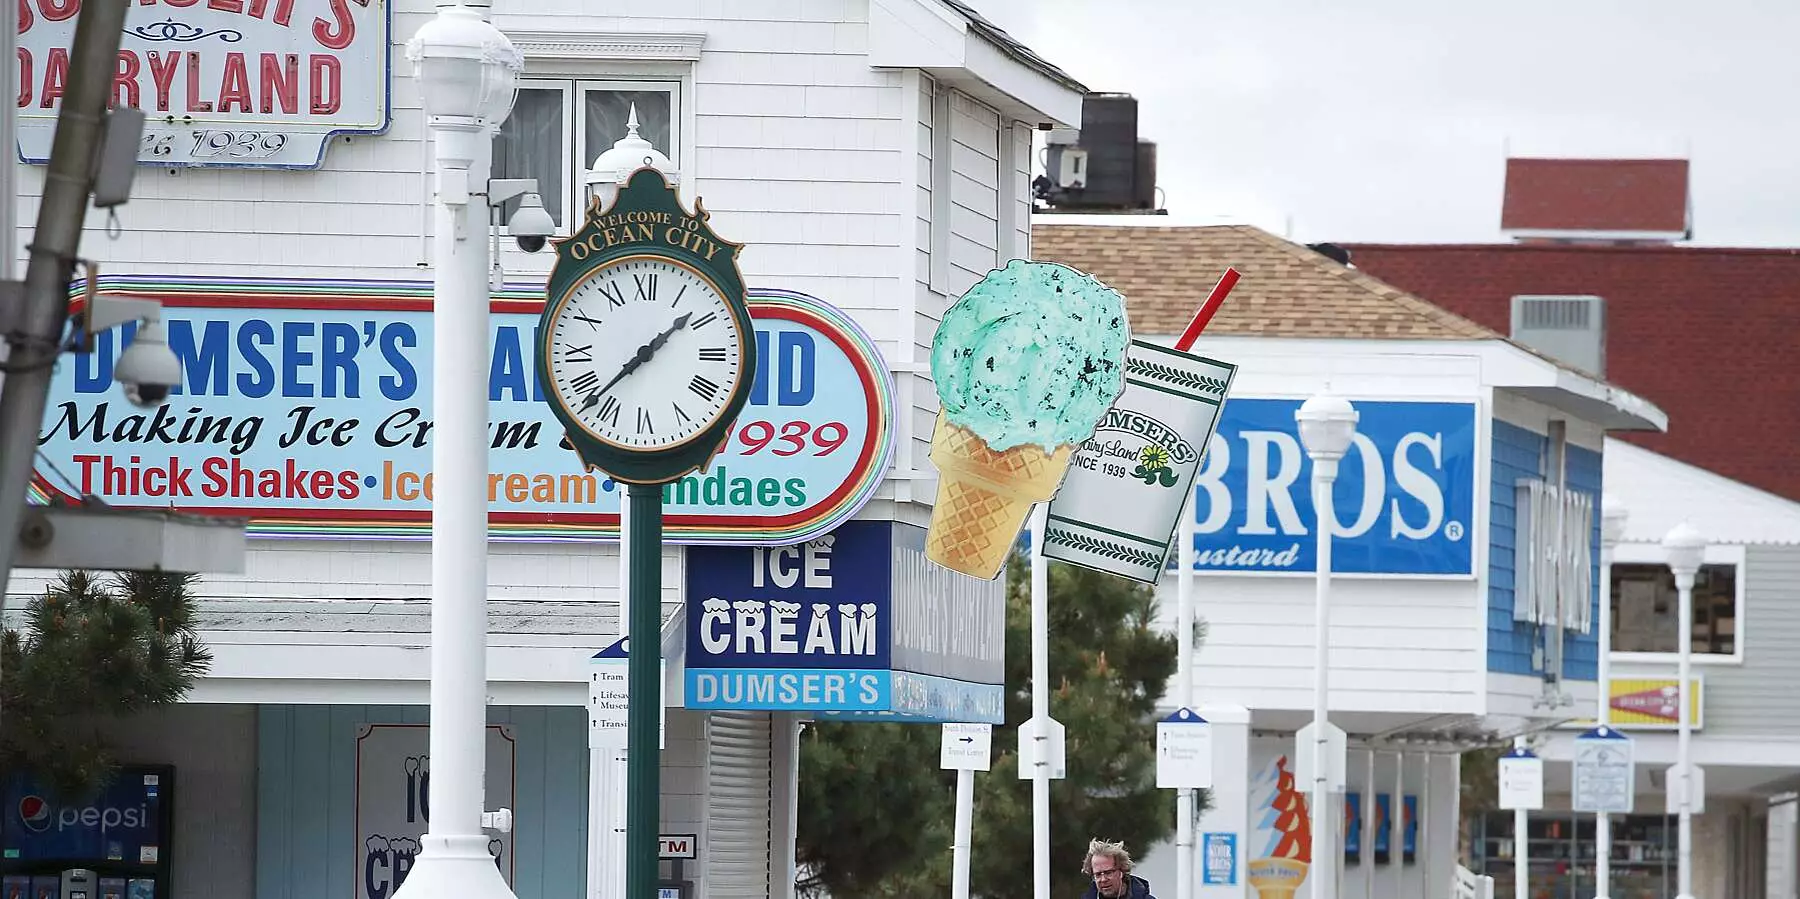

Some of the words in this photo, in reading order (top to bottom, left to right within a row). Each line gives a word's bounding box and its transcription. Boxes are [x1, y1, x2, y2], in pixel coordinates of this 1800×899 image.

[190, 131, 288, 157] 1939
[592, 211, 672, 230] WELCOME
[679, 216, 699, 232] TO
[571, 223, 655, 261] OCEAN
[665, 226, 722, 262] CITY
[632, 274, 658, 301] XII
[74, 319, 417, 401] DMSER'S
[40, 401, 264, 455] Making
[279, 406, 360, 449] Ice
[374, 408, 542, 450] Crm
[1080, 439, 1105, 458] airy
[1105, 440, 1142, 462] Land
[1074, 455, 1098, 471] NCE
[1102, 463, 1126, 478] 1939
[73, 454, 192, 498] Thick
[201, 457, 360, 500] Shakes
[488, 472, 597, 504] ream
[662, 466, 807, 506] ndaes
[753, 535, 836, 589] ICE
[1193, 543, 1299, 567] ustard
[700, 597, 877, 656] CREAM
[600, 672, 624, 681] Tram
[697, 672, 879, 704] DUMSER'S
[600, 691, 630, 699] Lifesav
[600, 702, 629, 710] Museu
[600, 719, 627, 728] Transi
[59, 803, 146, 833] pepsi
[659, 841, 687, 853] TM
